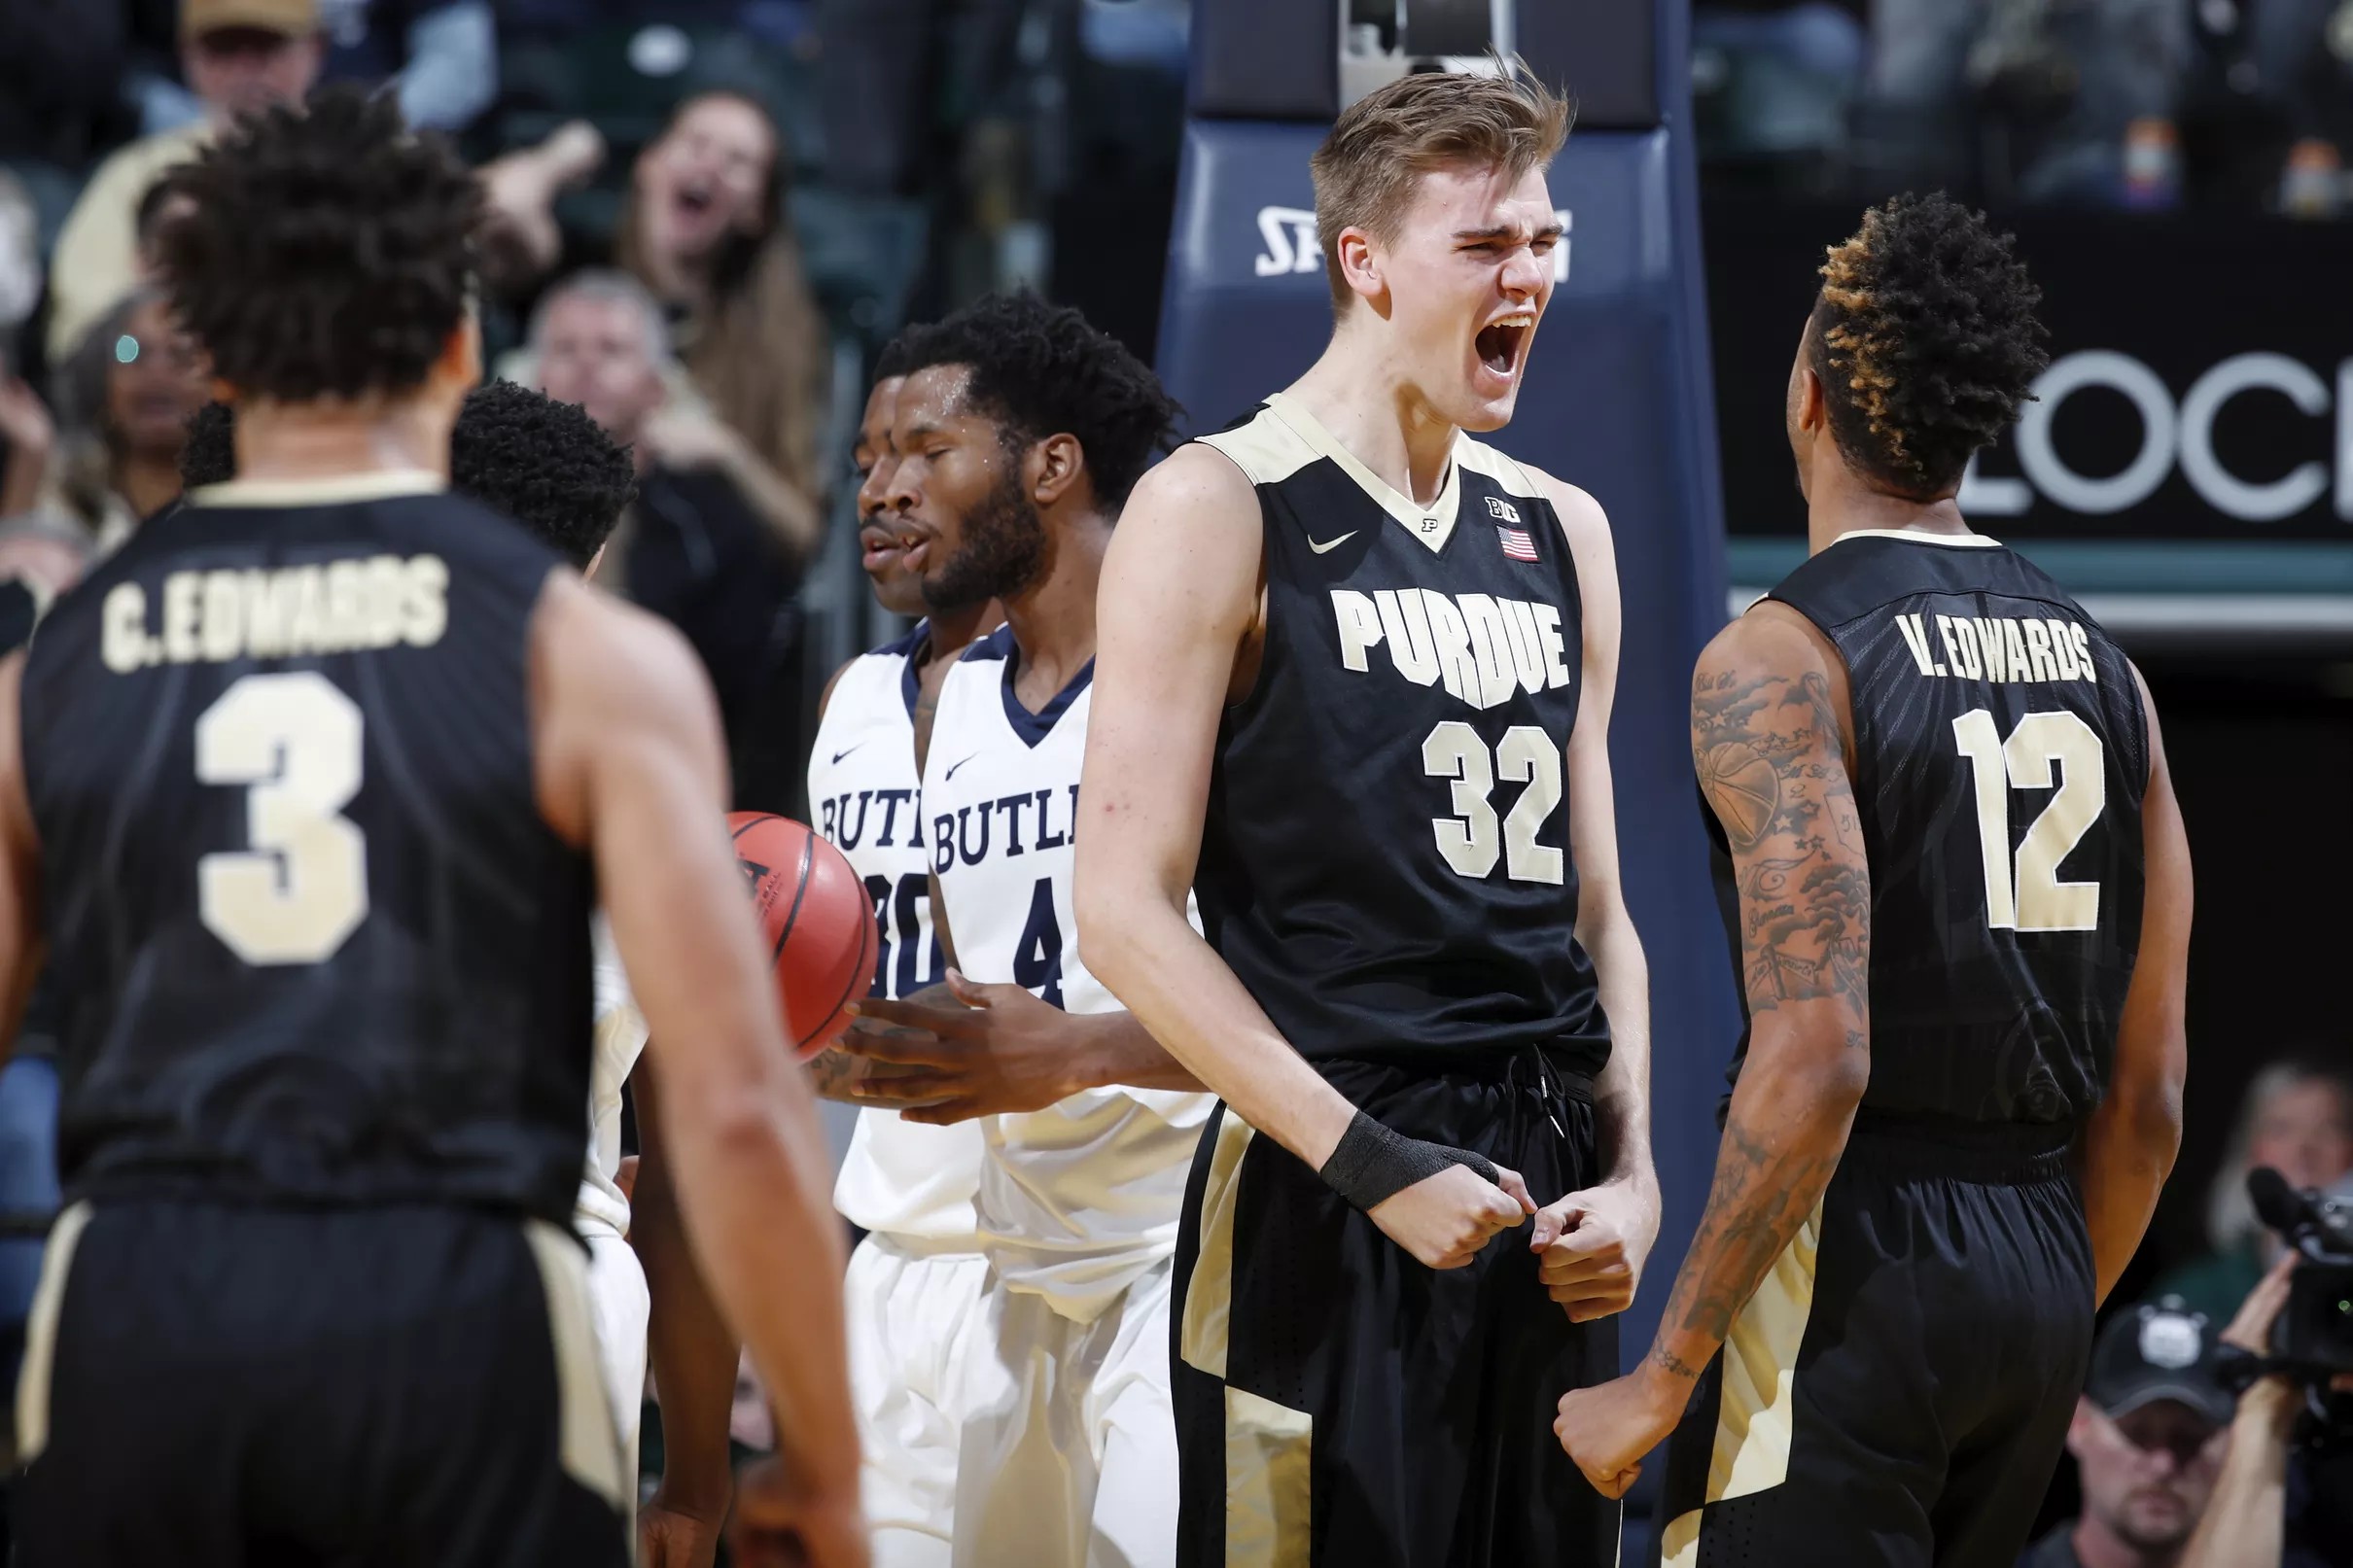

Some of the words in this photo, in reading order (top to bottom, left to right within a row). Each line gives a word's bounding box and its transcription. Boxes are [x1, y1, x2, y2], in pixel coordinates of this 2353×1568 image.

[1422, 518, 1438, 532] P
[101, 553, 449, 674] C.EDWARDS
[1330, 588, 1570, 711] PURDUE
[1895, 613, 2096, 682] V.EDWARDS
[194, 671, 369, 965] 3
[1422, 720, 1563, 885] 32
[1952, 709, 2105, 931] 12
[1013, 877, 1066, 1012] 4
